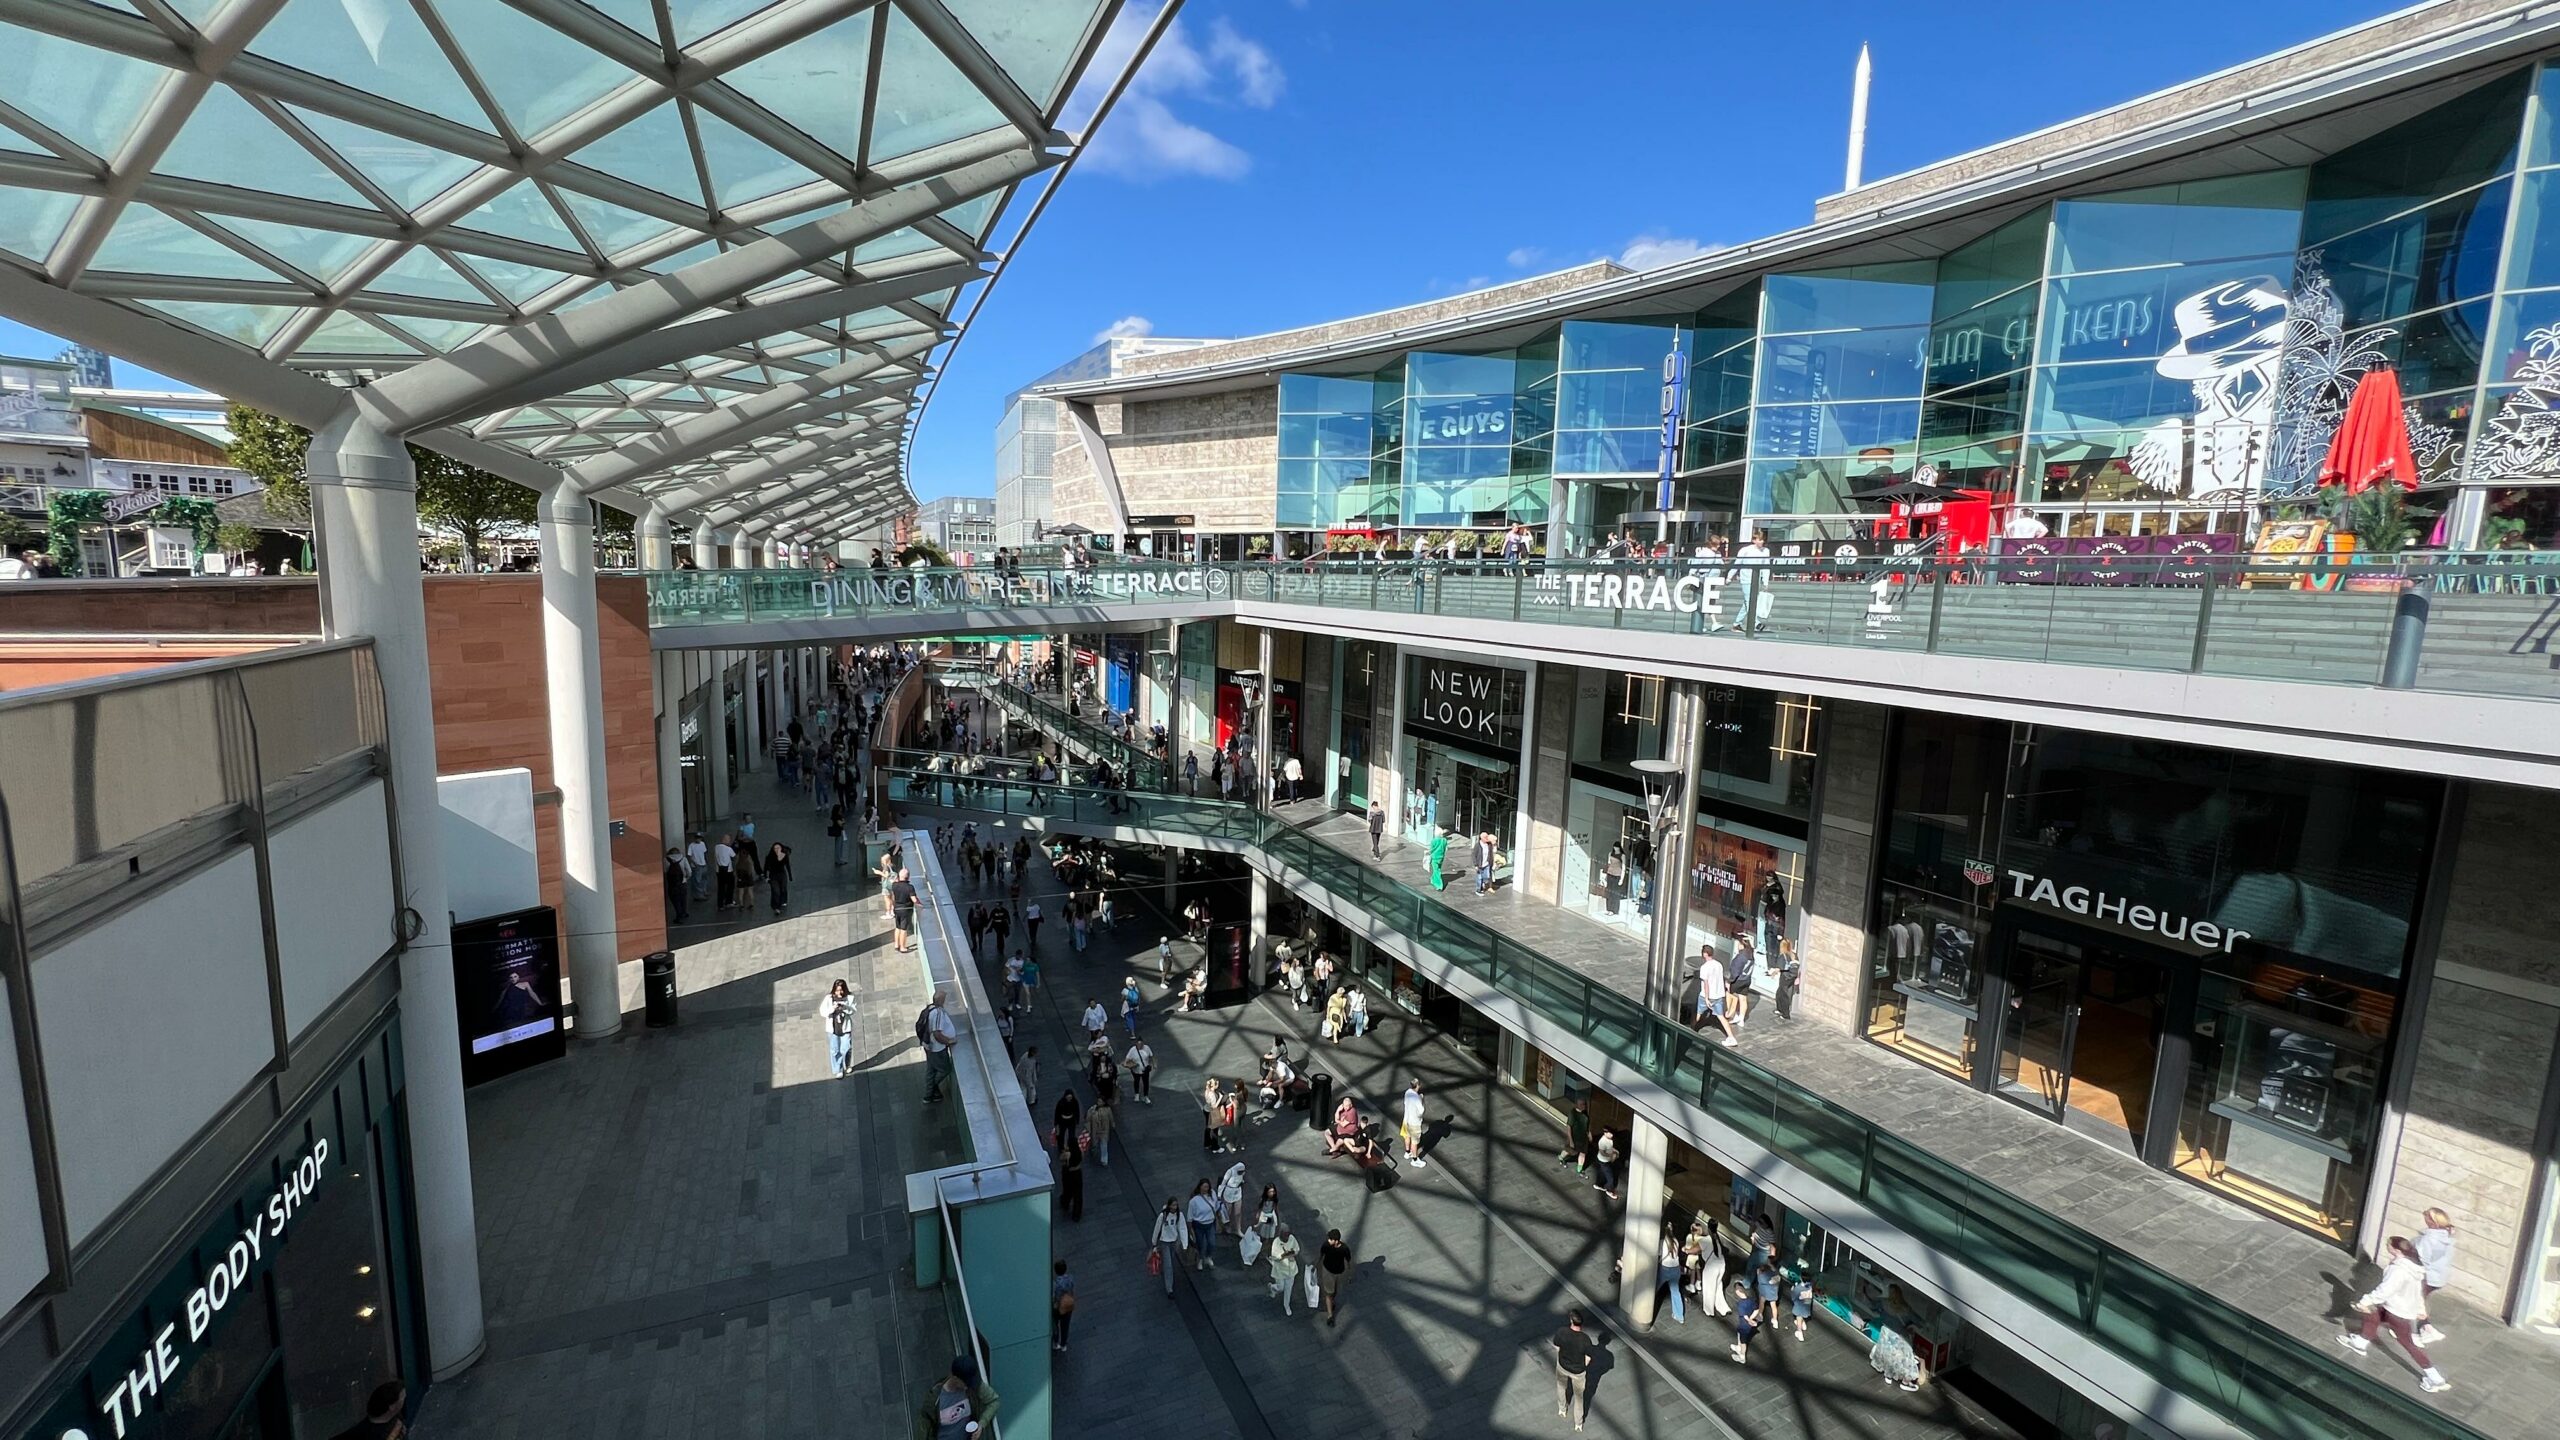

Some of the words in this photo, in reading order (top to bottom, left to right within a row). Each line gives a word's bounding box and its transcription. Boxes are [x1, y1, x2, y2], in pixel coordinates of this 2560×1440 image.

[1389, 420, 1436, 443] FE
[1441, 411, 1505, 438] GUYS
[2016, 542, 2050, 556] CANTINA
[2091, 542, 2128, 556] CANTINA
[2171, 539, 2213, 555] CANTINA
[811, 578, 912, 607] DINING
[921, 578, 935, 599] &
[944, 576, 1025, 600] MORE
[1097, 571, 1203, 594] TERRACE
[1534, 574, 1561, 590] THE
[1566, 574, 1725, 614] TERRACE
[1866, 614, 1903, 622] LIVERPOOL
[1430, 668, 1491, 700] NEW
[1423, 697, 1495, 735] LOOK
[1967, 861, 1992, 874] TAG
[103, 1321, 180, 1439] THE
[186, 1213, 263, 1343] BODY
[268, 1137, 328, 1237] SHOP
